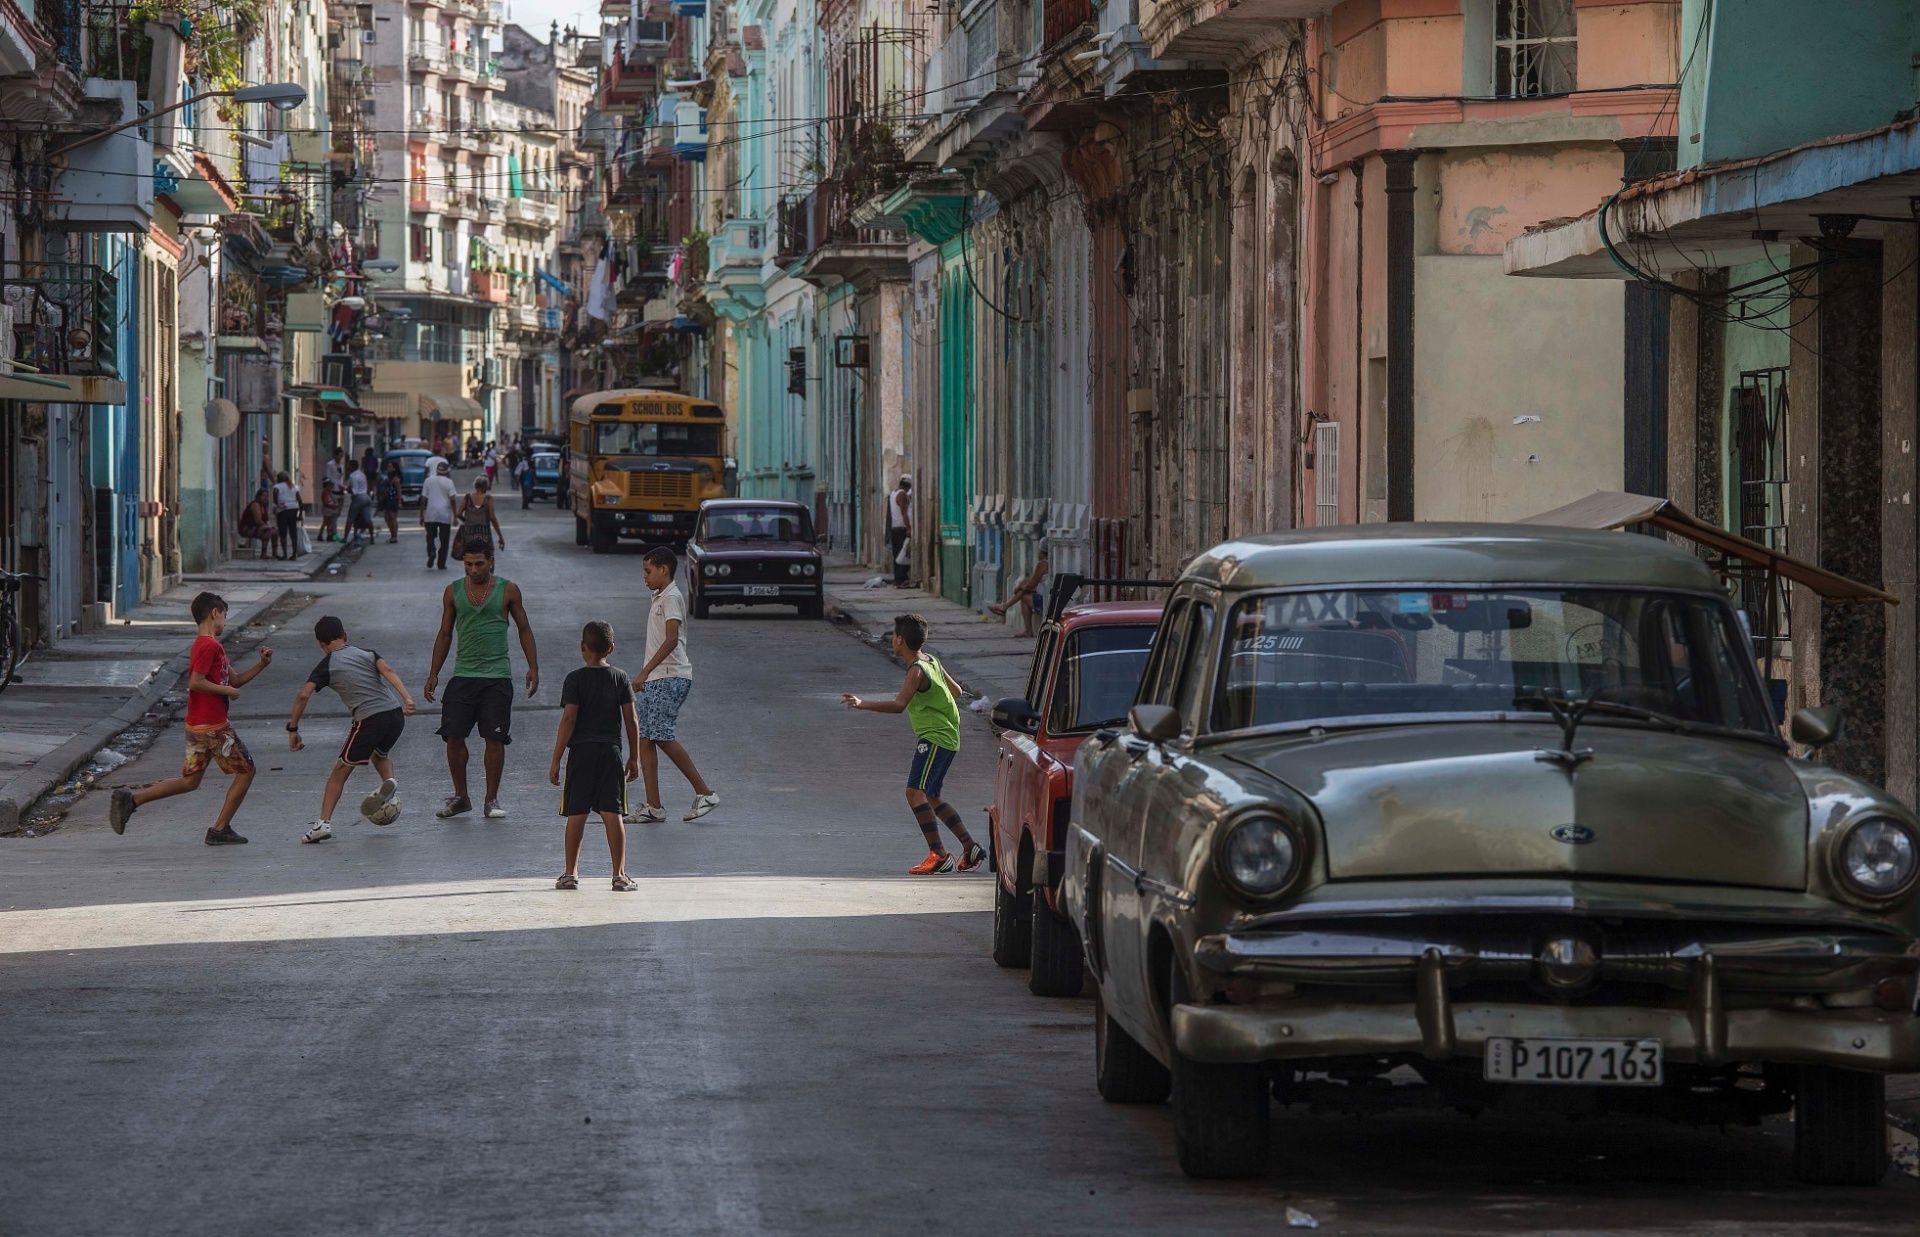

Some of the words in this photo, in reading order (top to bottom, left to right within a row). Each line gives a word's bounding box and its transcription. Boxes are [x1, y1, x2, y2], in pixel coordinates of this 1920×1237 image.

[632, 402, 664, 415] SCHOOL
[666, 403, 683, 416] BUS
[1266, 592, 1354, 626] TAXI
[1244, 635, 1278, 649] 125
[1561, 827, 1588, 840] Ford
[1494, 1043, 1502, 1074] CUBA
